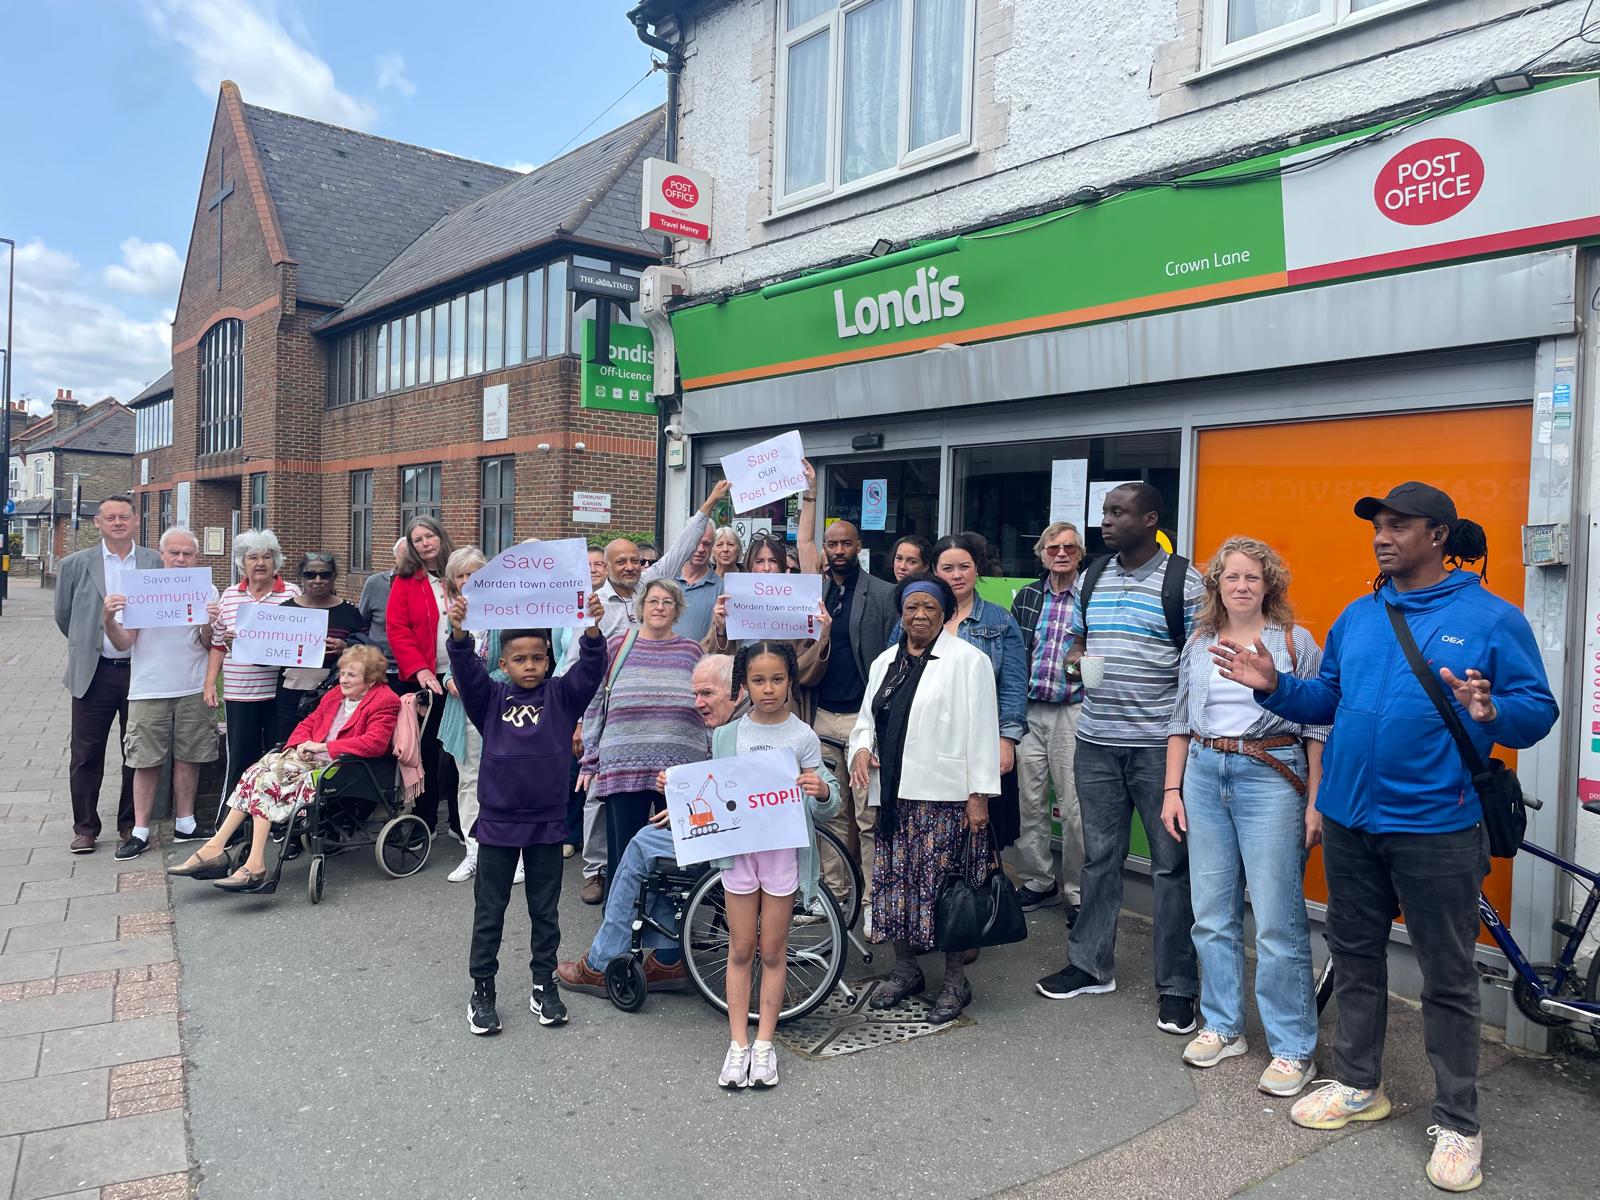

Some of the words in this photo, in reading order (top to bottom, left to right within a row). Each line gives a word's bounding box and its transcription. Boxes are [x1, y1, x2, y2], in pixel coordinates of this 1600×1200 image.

[1398, 152, 1461, 185] POST
[670, 180, 692, 193] POST
[1384, 174, 1471, 210] OFFICE
[665, 188, 695, 203] OFFICE
[660, 218, 679, 229] Travel
[679, 224, 699, 235] Money
[1165, 258, 1210, 277] Crown
[1213, 250, 1250, 268] Lane
[580, 275, 596, 285] THE
[611, 281, 634, 291] TIMES
[833, 266, 965, 338] Londis
[609, 343, 655, 365] ondis
[600, 366, 652, 381] Off-Licence
[747, 448, 779, 468] Save
[758, 466, 777, 479] OUR
[739, 487, 766, 503] Post
[502, 554, 555, 570] Save
[143, 575, 170, 585] Save
[174, 575, 193, 583] our
[474, 579, 516, 589] Morden
[519, 579, 546, 589] town
[550, 578, 584, 589] centre
[754, 582, 792, 596] Save
[127, 590, 208, 605] community
[484, 603, 519, 616] Post
[733, 602, 764, 610] Morden
[787, 604, 814, 612] centre
[257, 610, 285, 621] Save
[289, 615, 307, 623] our
[741, 619, 767, 630] Post
[239, 628, 322, 646] community
[747, 787, 801, 809] STOP!!
